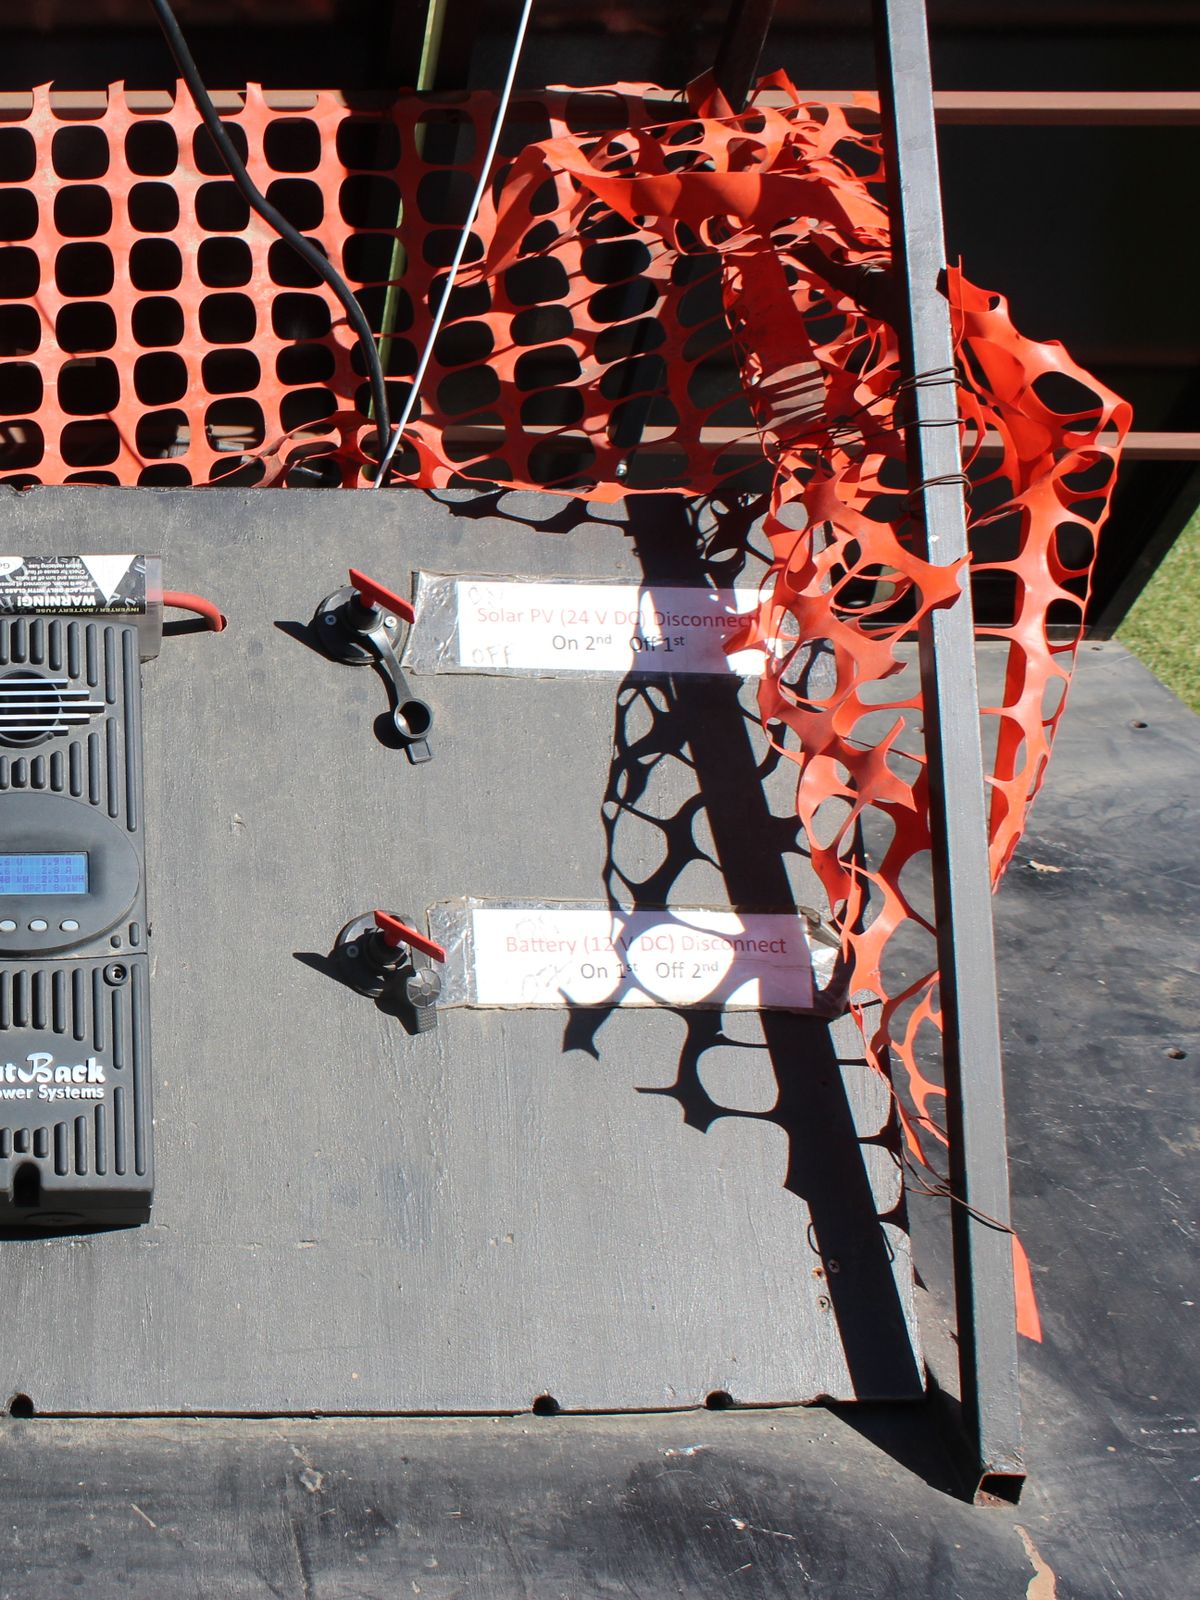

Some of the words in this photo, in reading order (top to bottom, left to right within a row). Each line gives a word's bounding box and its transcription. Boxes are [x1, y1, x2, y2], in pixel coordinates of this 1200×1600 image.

[17, 595, 97, 606] WARNING!
[477, 608, 523, 623] Solar
[531, 609, 554, 624] PV
[561, 608, 589, 628] (24
[593, 610, 608, 625] V
[615, 610, 647, 629] DC)
[553, 635, 579, 651] On
[585, 634, 612, 651] 2nd
[629, 635, 656, 652] Off
[663, 635, 686, 652] 1st
[506, 937, 575, 955] Battery
[583, 936, 614, 955] (12
[617, 937, 633, 952] V
[641, 936, 675, 955] DC)
[682, 935, 787, 954] Disconnect
[580, 963, 608, 979] On
[617, 962, 638, 979] 1st
[656, 962, 684, 979] Off
[692, 961, 719, 979] 2nd
[38, 1085, 105, 1102] Systems
